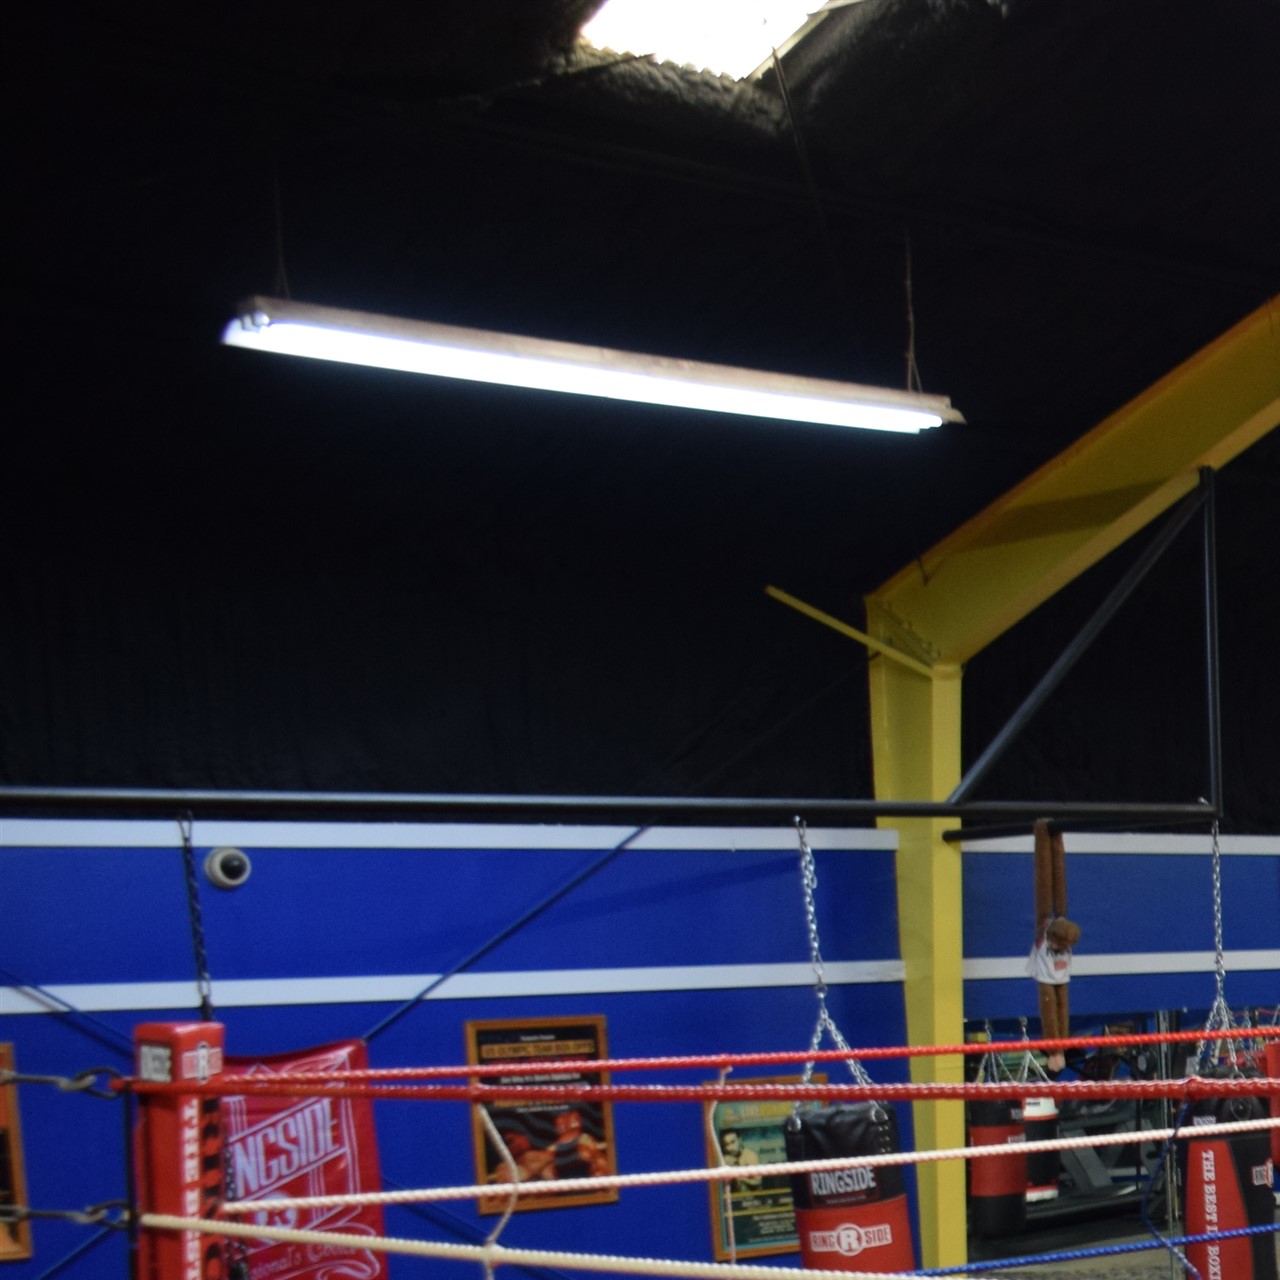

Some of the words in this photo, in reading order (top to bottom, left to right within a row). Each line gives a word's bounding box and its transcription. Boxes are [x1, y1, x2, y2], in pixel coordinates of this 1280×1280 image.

[234, 1099, 341, 1202] NGSIDE
[1202, 1150, 1216, 1182] THE
[811, 1166, 877, 1196] RINGSIDE
[1204, 1184, 1218, 1226] BEST
[812, 1233, 836, 1250] RING
[863, 1226, 889, 1245] SIDE
